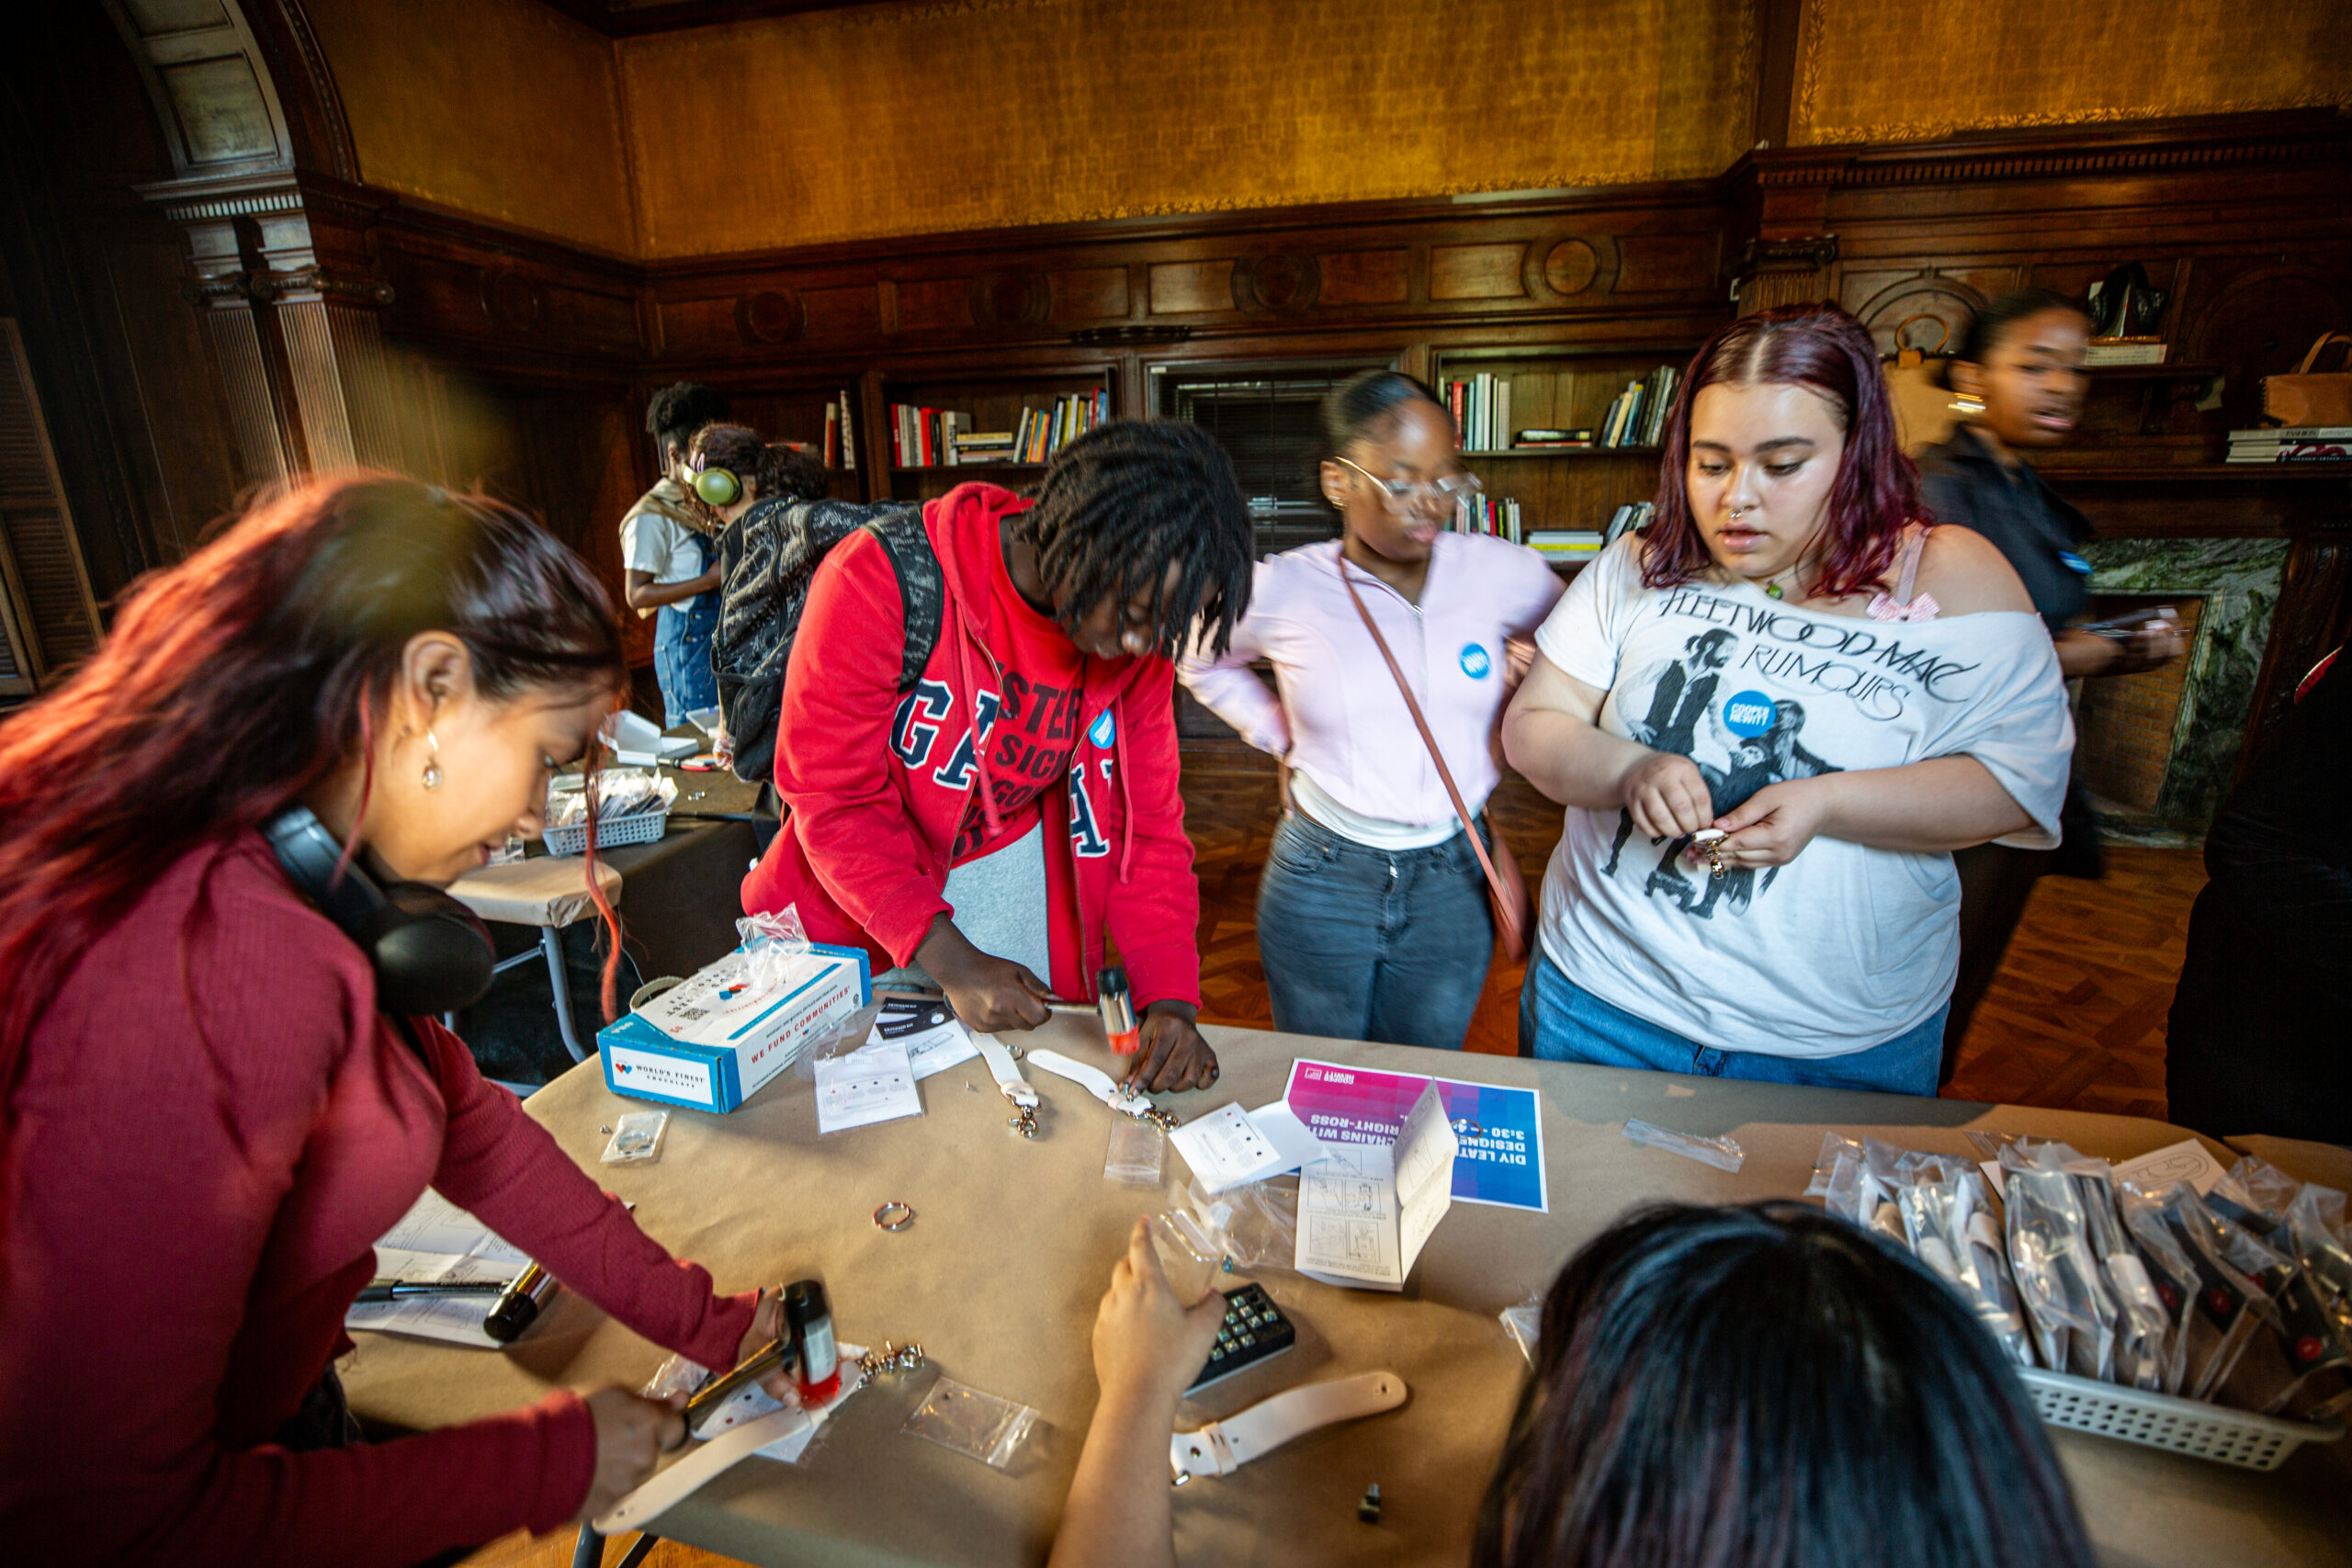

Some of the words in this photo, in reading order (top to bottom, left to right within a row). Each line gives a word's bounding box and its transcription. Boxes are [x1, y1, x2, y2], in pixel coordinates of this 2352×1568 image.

[1659, 586, 1879, 658] FLEETWOOD
[1872, 640, 1983, 704] MAC
[1739, 644, 1913, 723] RUMOURS
[1731, 703, 1770, 716] COOPER
[1728, 712, 1770, 726] HEWITT
[751, 1049, 765, 1064] WE
[767, 1030, 791, 1052] FUND
[794, 987, 850, 1032] COMMUNITIES
[636, 1065, 671, 1077] WORLD'S
[675, 1072, 705, 1084] FINEST
[1309, 1114, 1400, 1135] RIGHT-ROSS
[1308, 1126, 1338, 1140] WIT
[1340, 1130, 1396, 1146] CHAINS
[1491, 1127, 1525, 1141] 3:30
[1457, 1137, 1527, 1153] DESIGNE
[1498, 1152, 1527, 1167] DIY
